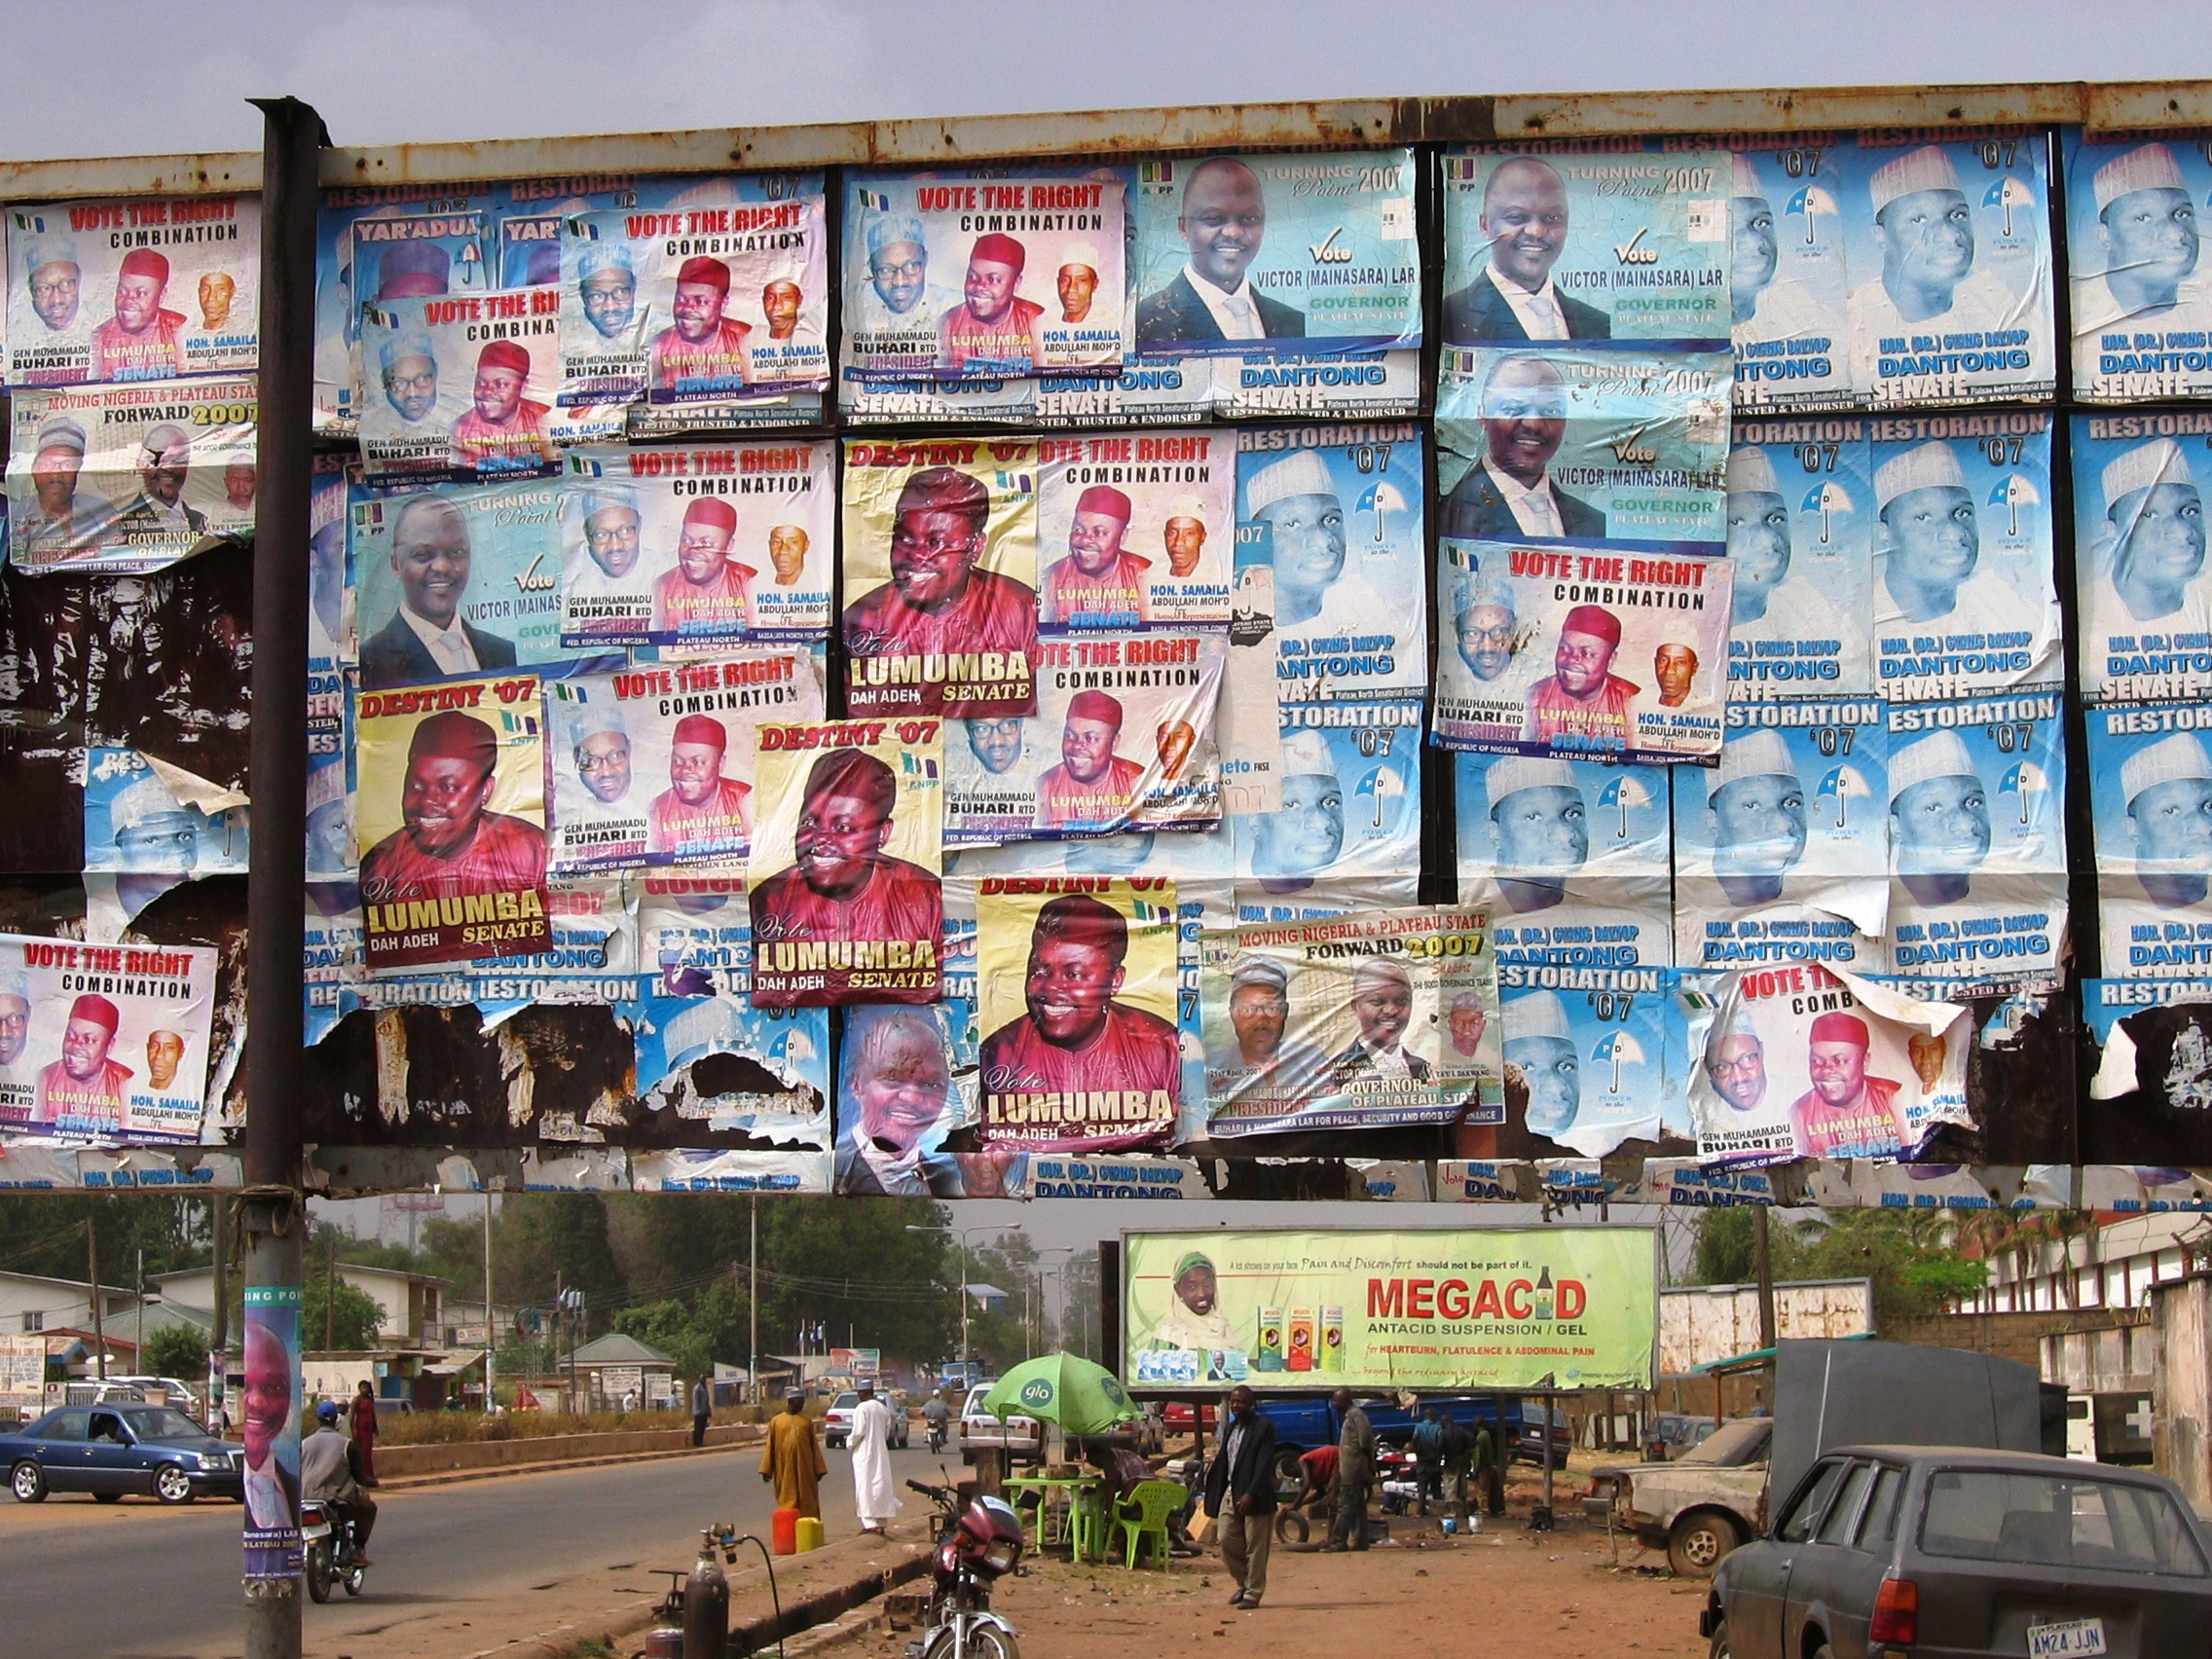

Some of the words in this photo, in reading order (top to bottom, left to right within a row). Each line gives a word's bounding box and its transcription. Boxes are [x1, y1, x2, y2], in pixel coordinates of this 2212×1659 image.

[1265, 166, 1353, 180] TURNING
[1359, 166, 1403, 193] 2007
[1567, 167, 1659, 180] TURNING
[1664, 167, 1715, 194] 2007
[917, 187, 977, 211] VOTE
[979, 187, 1024, 210] THE
[1032, 185, 1102, 209] RIGHT
[69, 205, 124, 231] VOTE
[128, 202, 167, 227] THE
[172, 198, 237, 223] RIGHT
[625, 213, 682, 239] VOTE
[685, 211, 728, 235] THE
[735, 204, 802, 233] RIGHT
[960, 214, 1102, 232] COMBINATION
[110, 224, 238, 248] COMBINATION
[666, 233, 804, 256] COMBINATION
[1310, 227, 1351, 264] Vote
[1614, 228, 1658, 264] Vote
[1257, 271, 1302, 288] VICTOR
[1307, 269, 1387, 290] (MAINASARA)
[1392, 267, 1416, 284] LAR
[1561, 272, 1606, 288] VICTOR
[1611, 271, 1694, 290] (MAINASARA)
[1698, 269, 1722, 286] LAR
[1310, 296, 1410, 310] GOVERNOR
[1616, 298, 1715, 311] GOVERNOR
[854, 332, 873, 341] GEN
[875, 331, 937, 341] MUHAMMADU
[952, 335, 1032, 347] LUMUMBA
[1044, 331, 1069, 341] HON.
[1074, 331, 1120, 341] SAMAILA
[1044, 343, 1089, 352] ABDULLAHI
[854, 343, 915, 353] BUHARI
[920, 344, 937, 352] RTD
[13, 357, 71, 369] BUHARI
[1878, 350, 2030, 377] DANTONG
[1240, 366, 1385, 387] DANTONG
[1872, 375, 1966, 399] SENATE
[49, 395, 99, 410] MOVING
[104, 392, 155, 406] NIGERIA
[160, 392, 166, 402] &
[171, 387, 226, 403] PLATEAU
[1233, 389, 1325, 409] SENATE
[104, 406, 189, 424] FORWARD
[685, 420, 736, 428] TRUSTED
[1236, 424, 1414, 452] RESTORATION
[629, 453, 687, 477] VOTE
[693, 451, 736, 473] THE
[742, 448, 812, 473] RIGHT
[849, 443, 978, 467] DESTINY
[1347, 446, 1391, 472] '07
[1794, 444, 1839, 472] '07
[673, 476, 812, 497] COMBINATION
[1066, 467, 1209, 483] COMBINATION
[1511, 551, 1572, 578] VOTE
[1579, 555, 1624, 582] THE
[1630, 561, 1706, 587] RIGHT
[1554, 584, 1704, 609] COMBINATION
[569, 606, 631, 617] BUHARI
[851, 651, 1030, 686] LUMUMBA
[1879, 652, 2031, 678] DANTONG
[613, 670, 672, 700] VOTE
[676, 662, 719, 690] THE
[724, 656, 795, 686] RIGHT
[1056, 670, 1199, 688] COMBINATION
[360, 685, 485, 719] DESTINY
[942, 683, 1030, 701] SENATE
[759, 724, 886, 751] DESTINY
[1810, 728, 1856, 756] '07
[363, 875, 422, 903] Vote
[368, 889, 544, 933] LUMUMBA
[371, 938, 398, 951] DAH
[403, 933, 439, 947] ADEH
[462, 921, 545, 943] SENATE
[1238, 933, 1299, 947] MOVING
[1303, 925, 1362, 941] NIGERIA
[1366, 925, 1375, 934] &
[1381, 919, 1444, 934] PLATEAU
[1447, 914, 1486, 929] STATE
[757, 940, 936, 972] LUMUMBA
[1305, 939, 1402, 960] FORWARD
[1405, 935, 1483, 959] 2007
[1895, 936, 2048, 967] DANTONG
[25, 943, 77, 969] VOTE
[84, 947, 121, 972] THE
[126, 951, 194, 978] RIGHT
[62, 975, 190, 998] COMBINATION
[758, 977, 786, 990] DAH
[791, 976, 825, 989] ADEH
[848, 972, 936, 988] SENATE
[1588, 993, 1633, 1021] '07
[1341, 1080, 1422, 1095] GOVERNOR
[988, 1089, 1173, 1124] LUMUMBA
[1362, 1113, 1400, 1123] SECURITY
[1402, 1112, 1418, 1122] AND
[1420, 1111, 1443, 1120] GOOD
[1301, 1257, 1328, 1271] Pain
[1331, 1258, 1351, 1272] and
[1355, 1257, 1412, 1275] Discomfort
[1487, 1261, 1506, 1271] part
[1368, 1323, 1436, 1334] ANTACID
[1441, 1324, 1541, 1335] SUSPENSION
[1557, 1325, 1587, 1335] GEL
[1380, 1346, 1440, 1355] HEARTBURN,
[1025, 1385, 1049, 1400] glo
